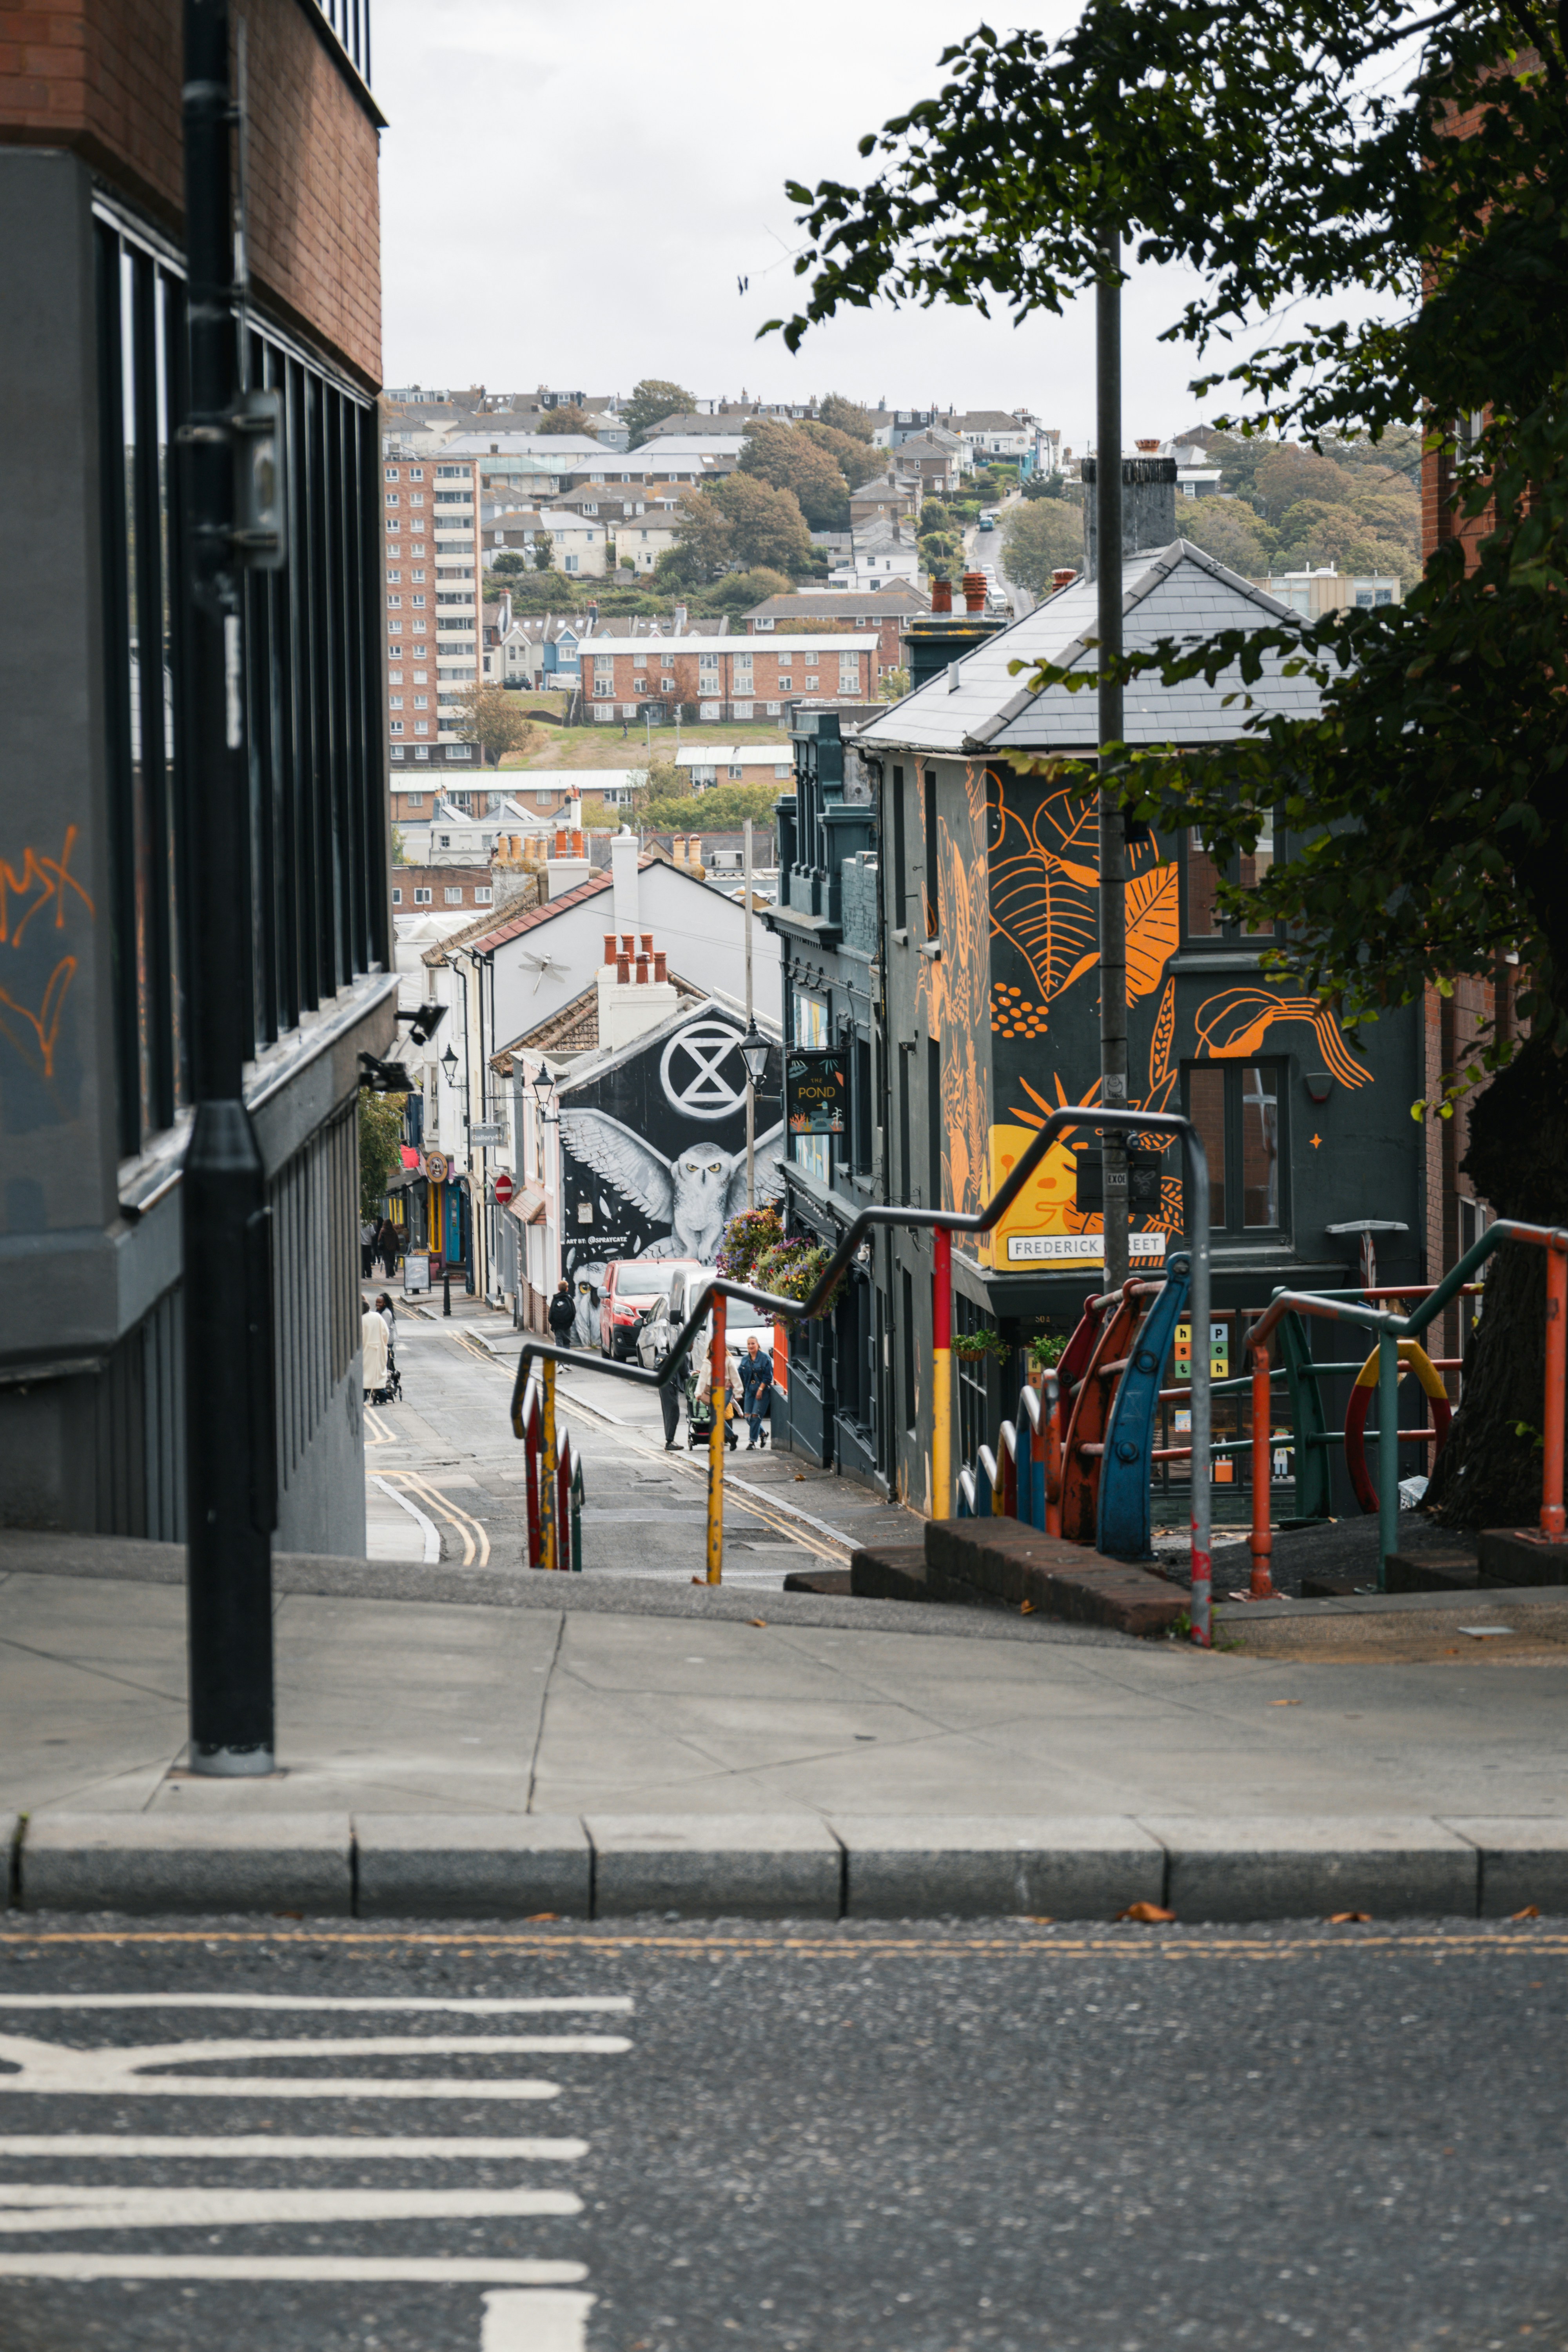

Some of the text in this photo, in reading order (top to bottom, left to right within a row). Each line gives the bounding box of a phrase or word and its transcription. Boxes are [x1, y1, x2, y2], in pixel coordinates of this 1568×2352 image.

[799, 1087, 835, 1098] POND
[1016, 1238, 1159, 1254] FREDERICK EET
